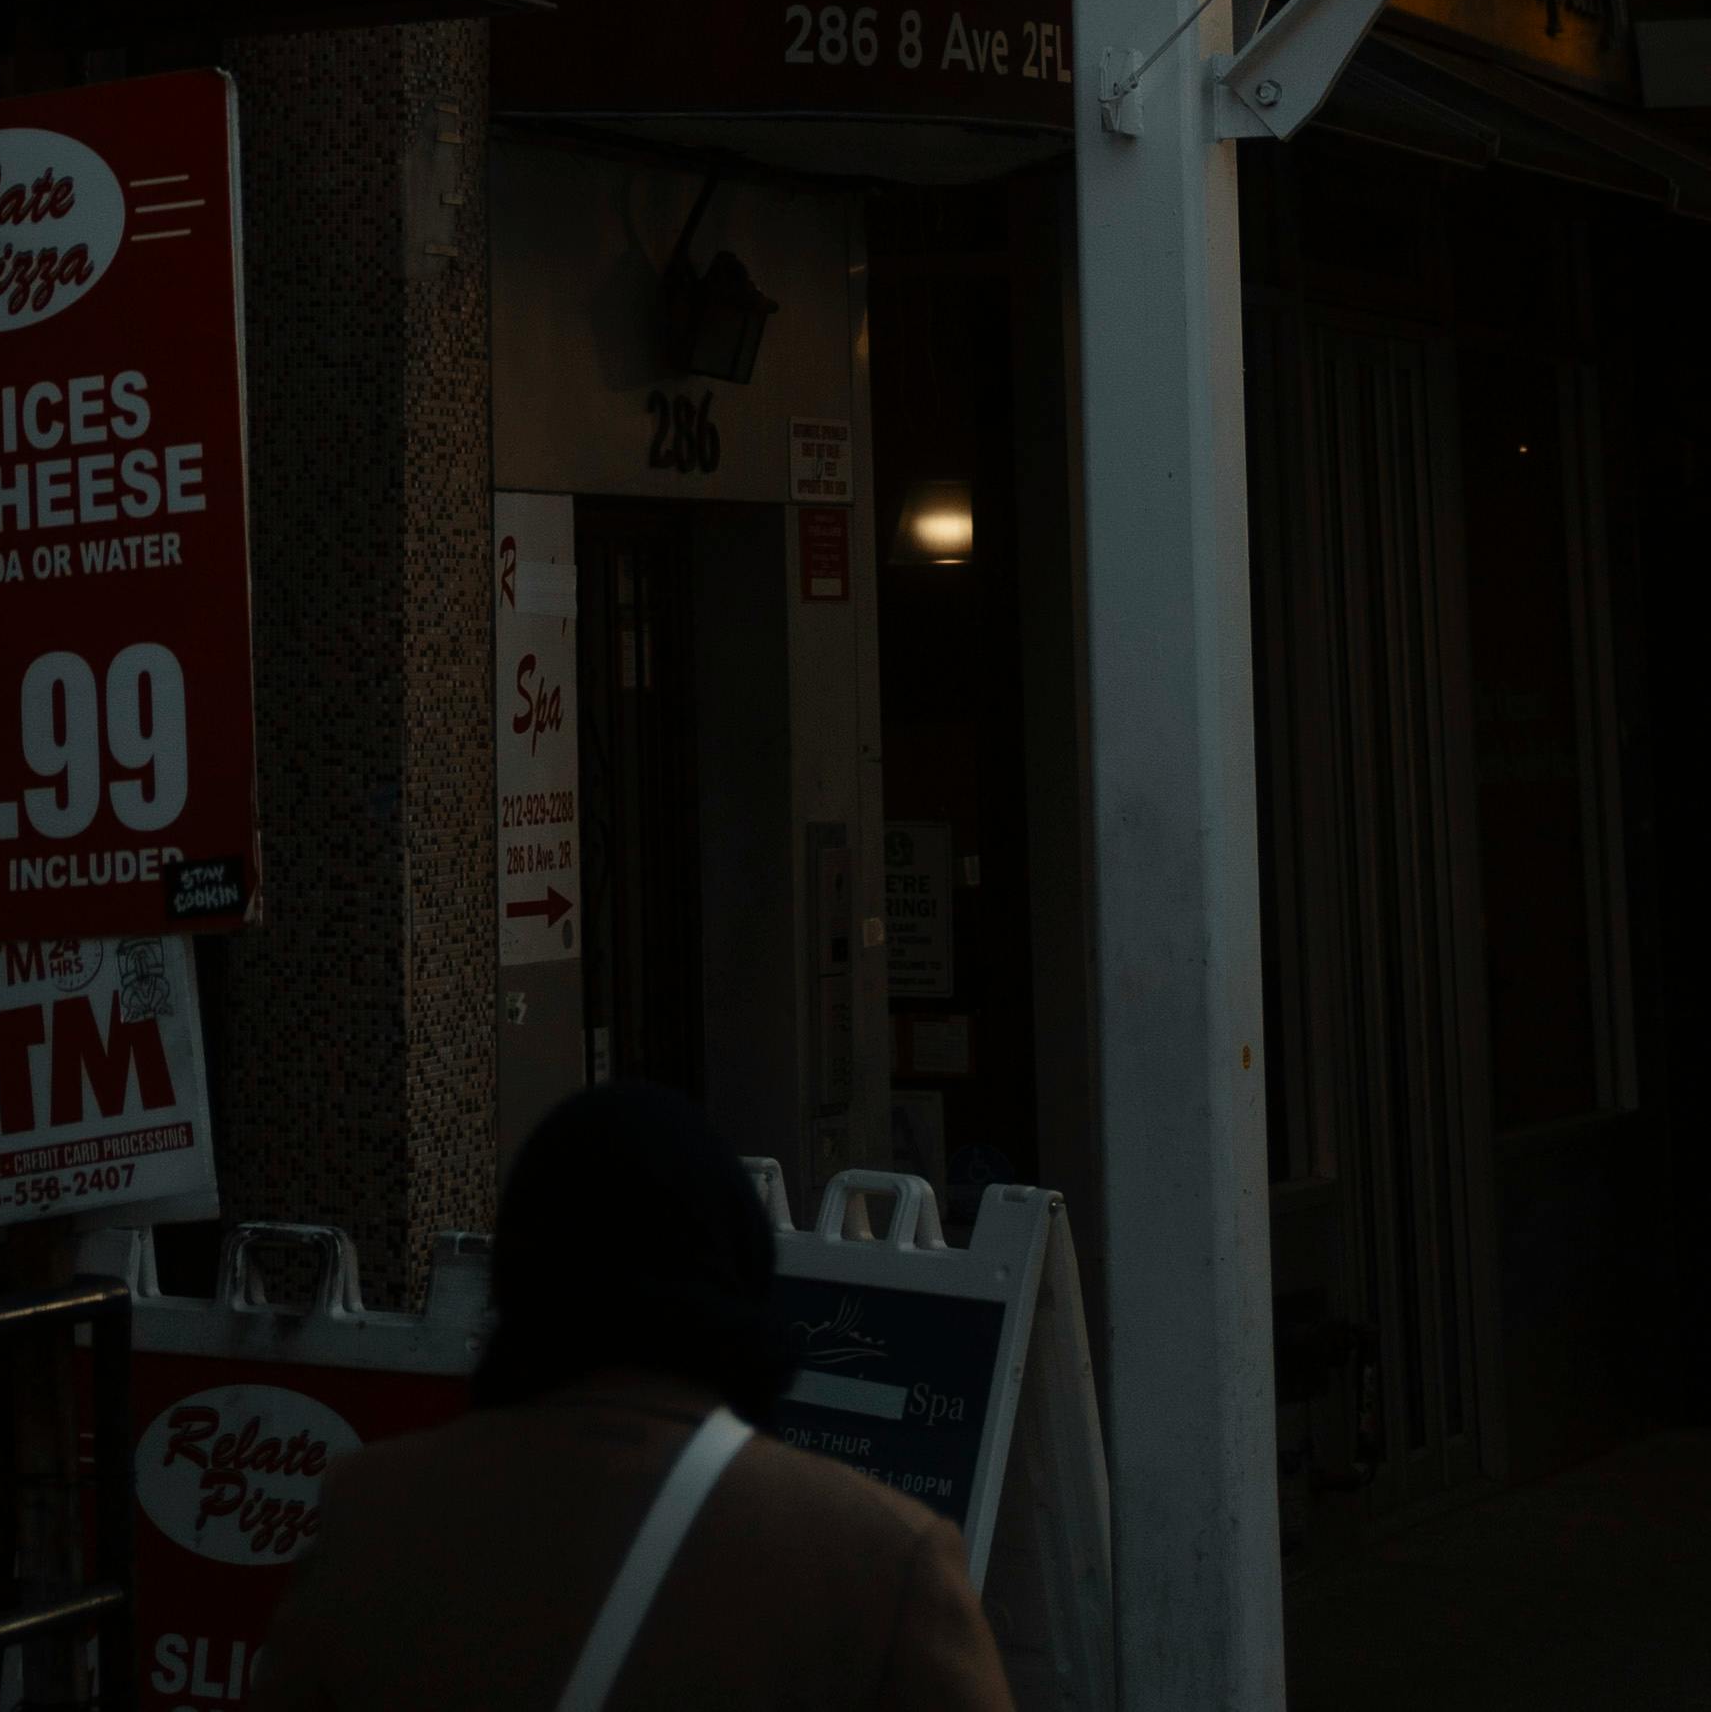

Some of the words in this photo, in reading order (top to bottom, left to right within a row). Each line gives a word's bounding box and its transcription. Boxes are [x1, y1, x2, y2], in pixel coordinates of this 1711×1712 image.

[784, 4, 879, 67] 286
[898, 9, 924, 69] 8
[941, 12, 1009, 75] Ave
[647, 389, 721, 474] 286
[32, 543, 72, 579] OR
[79, 531, 183, 576] WATER
[513, 653, 564, 758] Spa
[506, 845, 525, 875] 286
[527, 844, 534, 873] 8
[49, 959, 85, 979] HRS
[14, 1144, 59, 1175] CREDIT
[64, 1137, 99, 1165] CARD
[104, 1125, 188, 1158] PROCESSING
[909, 1382, 966, 1425] Spa
[164, 1406, 328, 1477] Relate
[779, 1427, 871, 1456] ON-THUR
